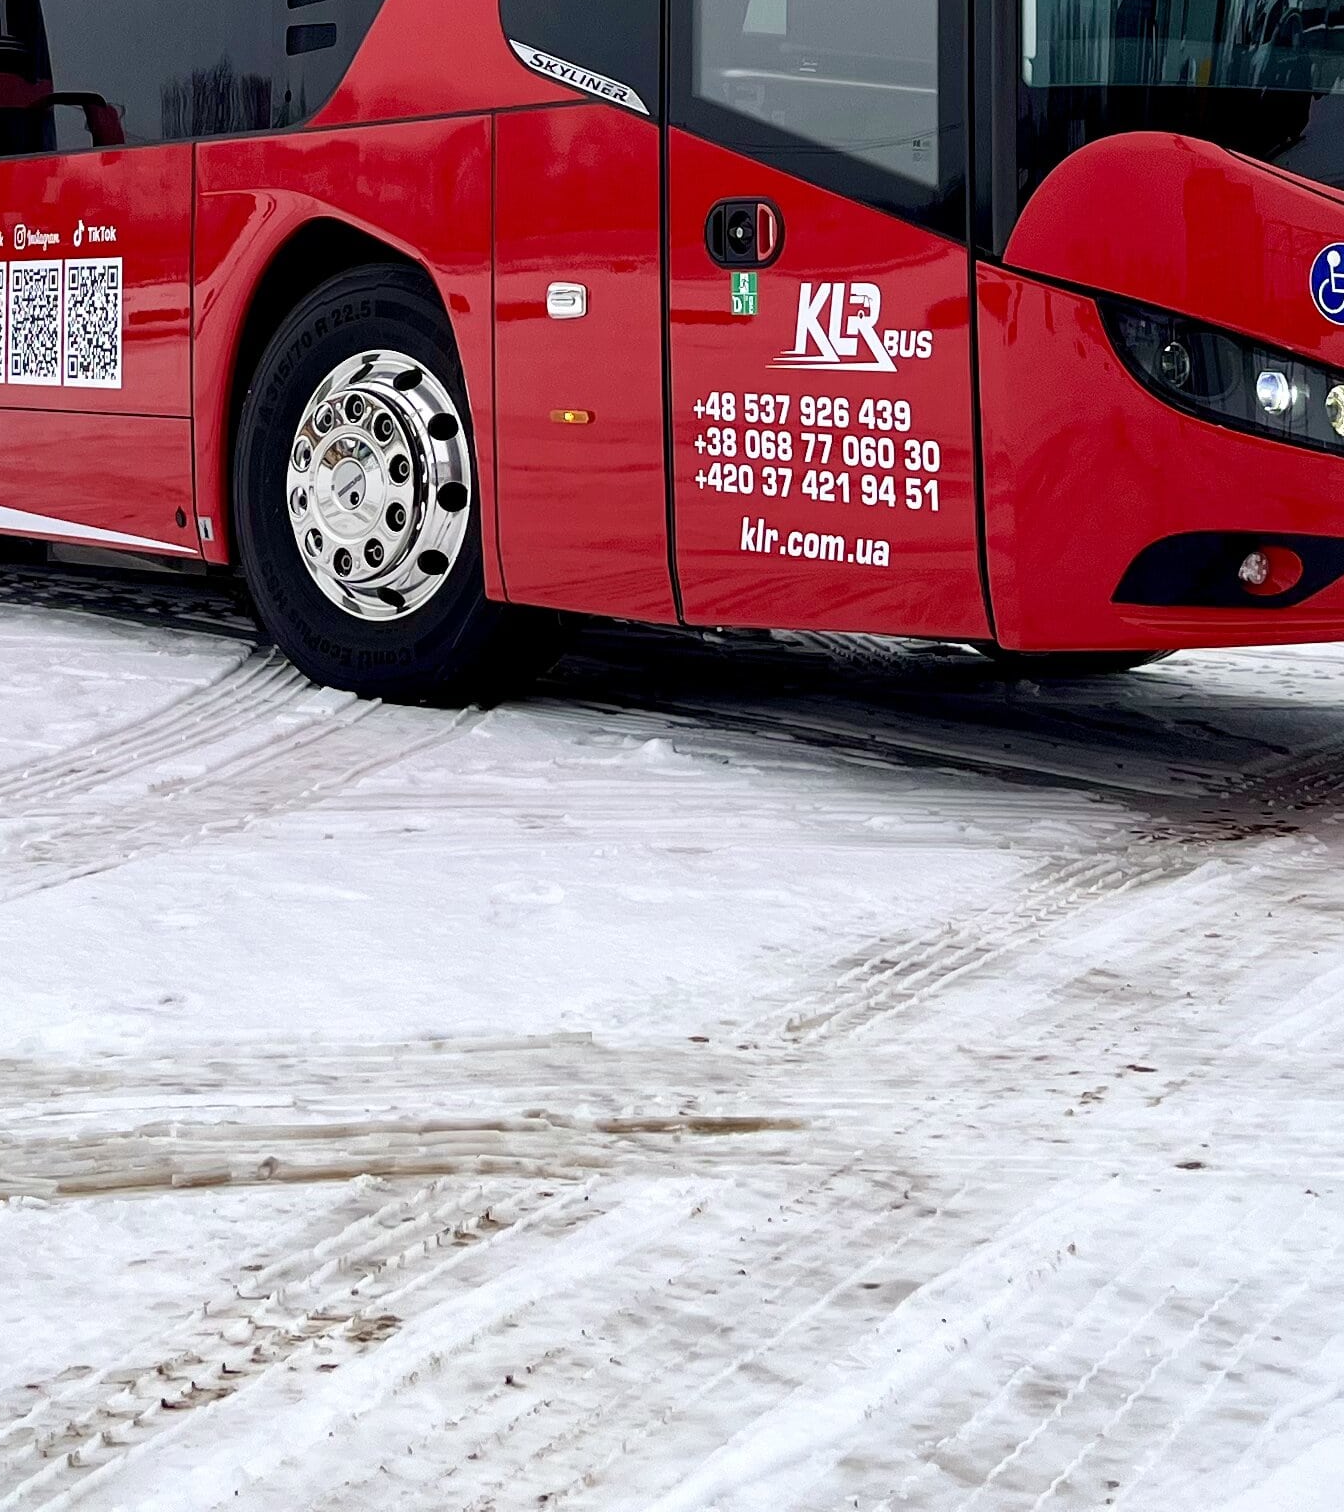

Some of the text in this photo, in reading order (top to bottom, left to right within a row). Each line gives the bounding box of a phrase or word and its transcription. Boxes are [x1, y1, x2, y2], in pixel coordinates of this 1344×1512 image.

[529, 53, 628, 102] SKYLINER
[27, 229, 60, 251] Instagram
[87, 225, 118, 243] TikTok
[331, 300, 372, 327] 22.5
[765, 282, 933, 372] KLR BUS
[693, 391, 911, 432] +48 537 926 439
[694, 427, 941, 472] +38 068 77 060 30
[695, 462, 939, 511] +420 37 421 94 51
[740, 516, 890, 567] klr.com.ua
